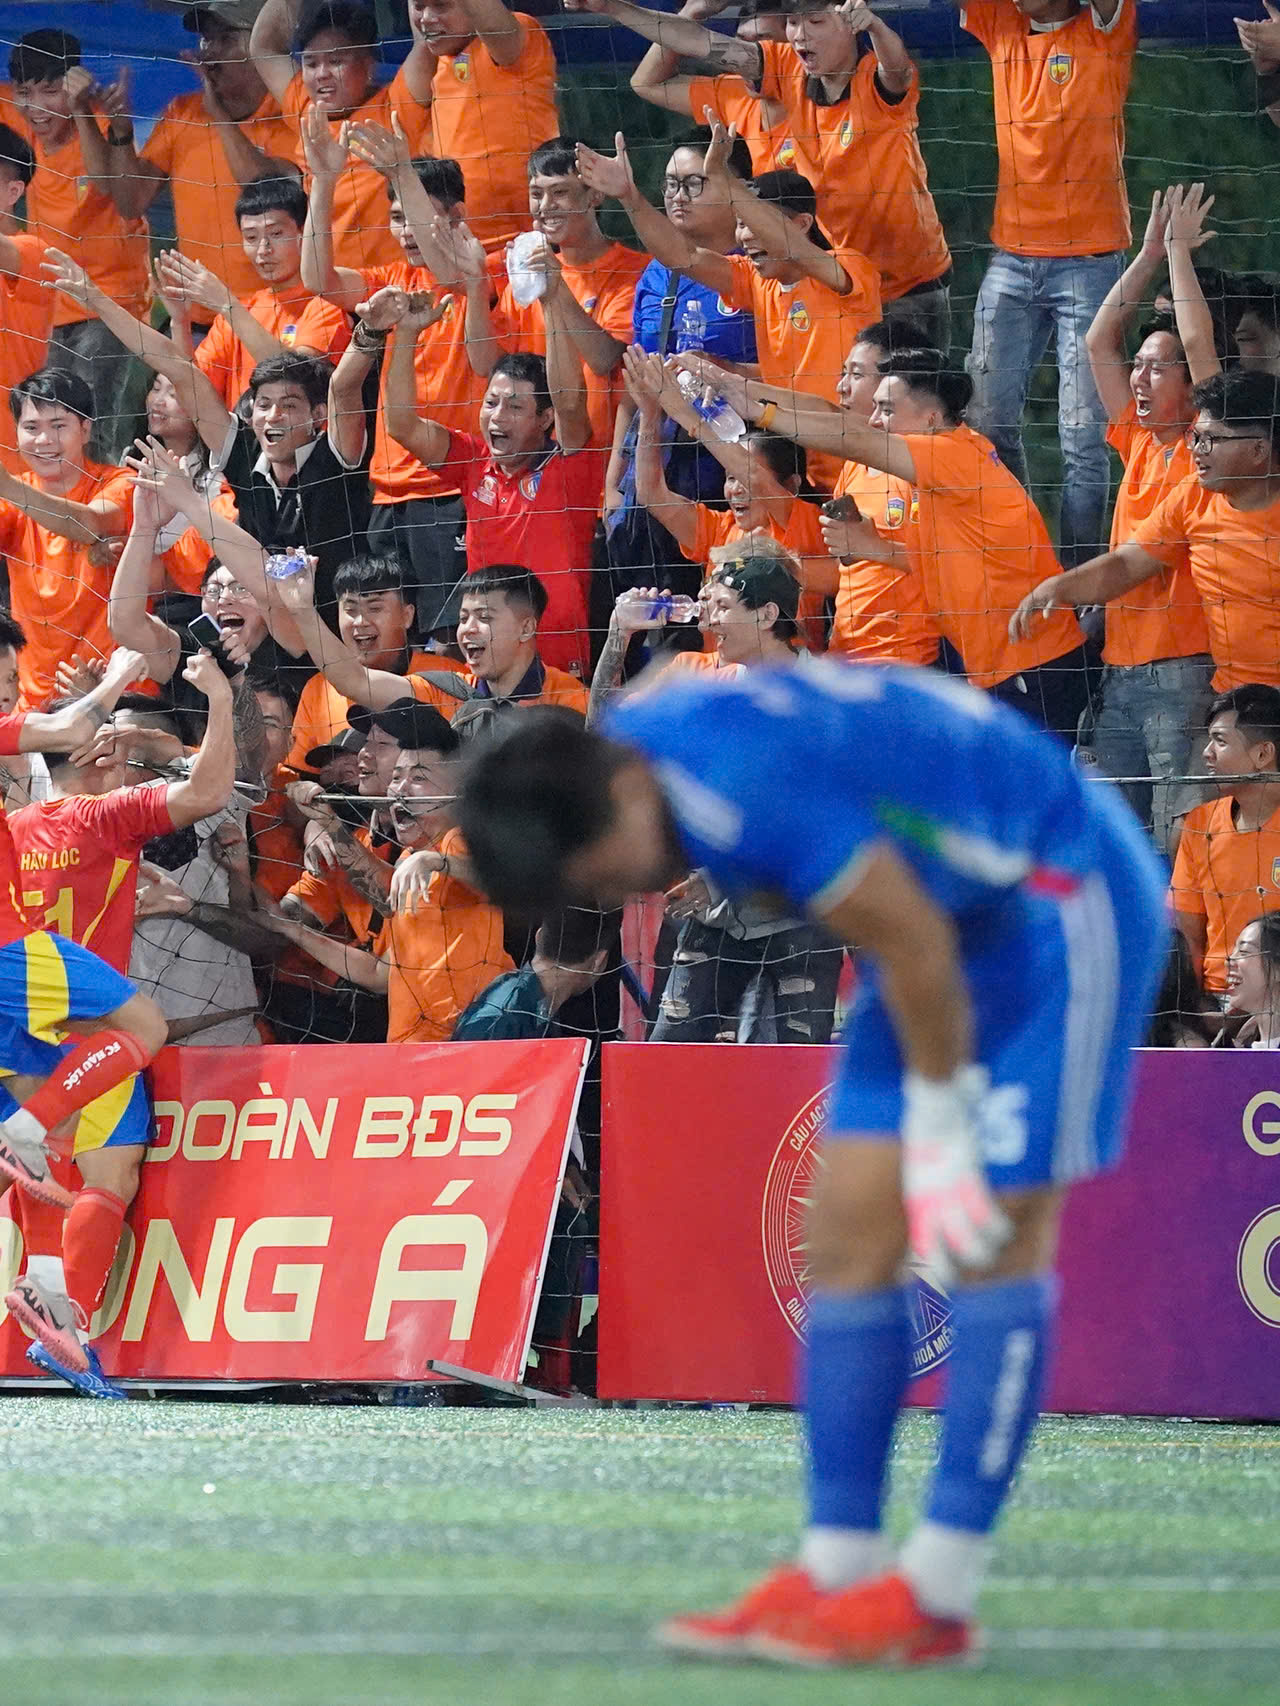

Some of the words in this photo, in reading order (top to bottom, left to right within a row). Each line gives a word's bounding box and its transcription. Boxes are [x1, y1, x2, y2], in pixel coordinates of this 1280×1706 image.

[21, 848, 48, 875] HẬU
[52, 847, 81, 872] LỘC
[82, 1048, 106, 1073] HẬU
[104, 1041, 121, 1057] FC
[63, 1069, 84, 1091] LỘC
[353, 1094, 518, 1159] BĐS
[365, 1180, 489, 1342] Á
